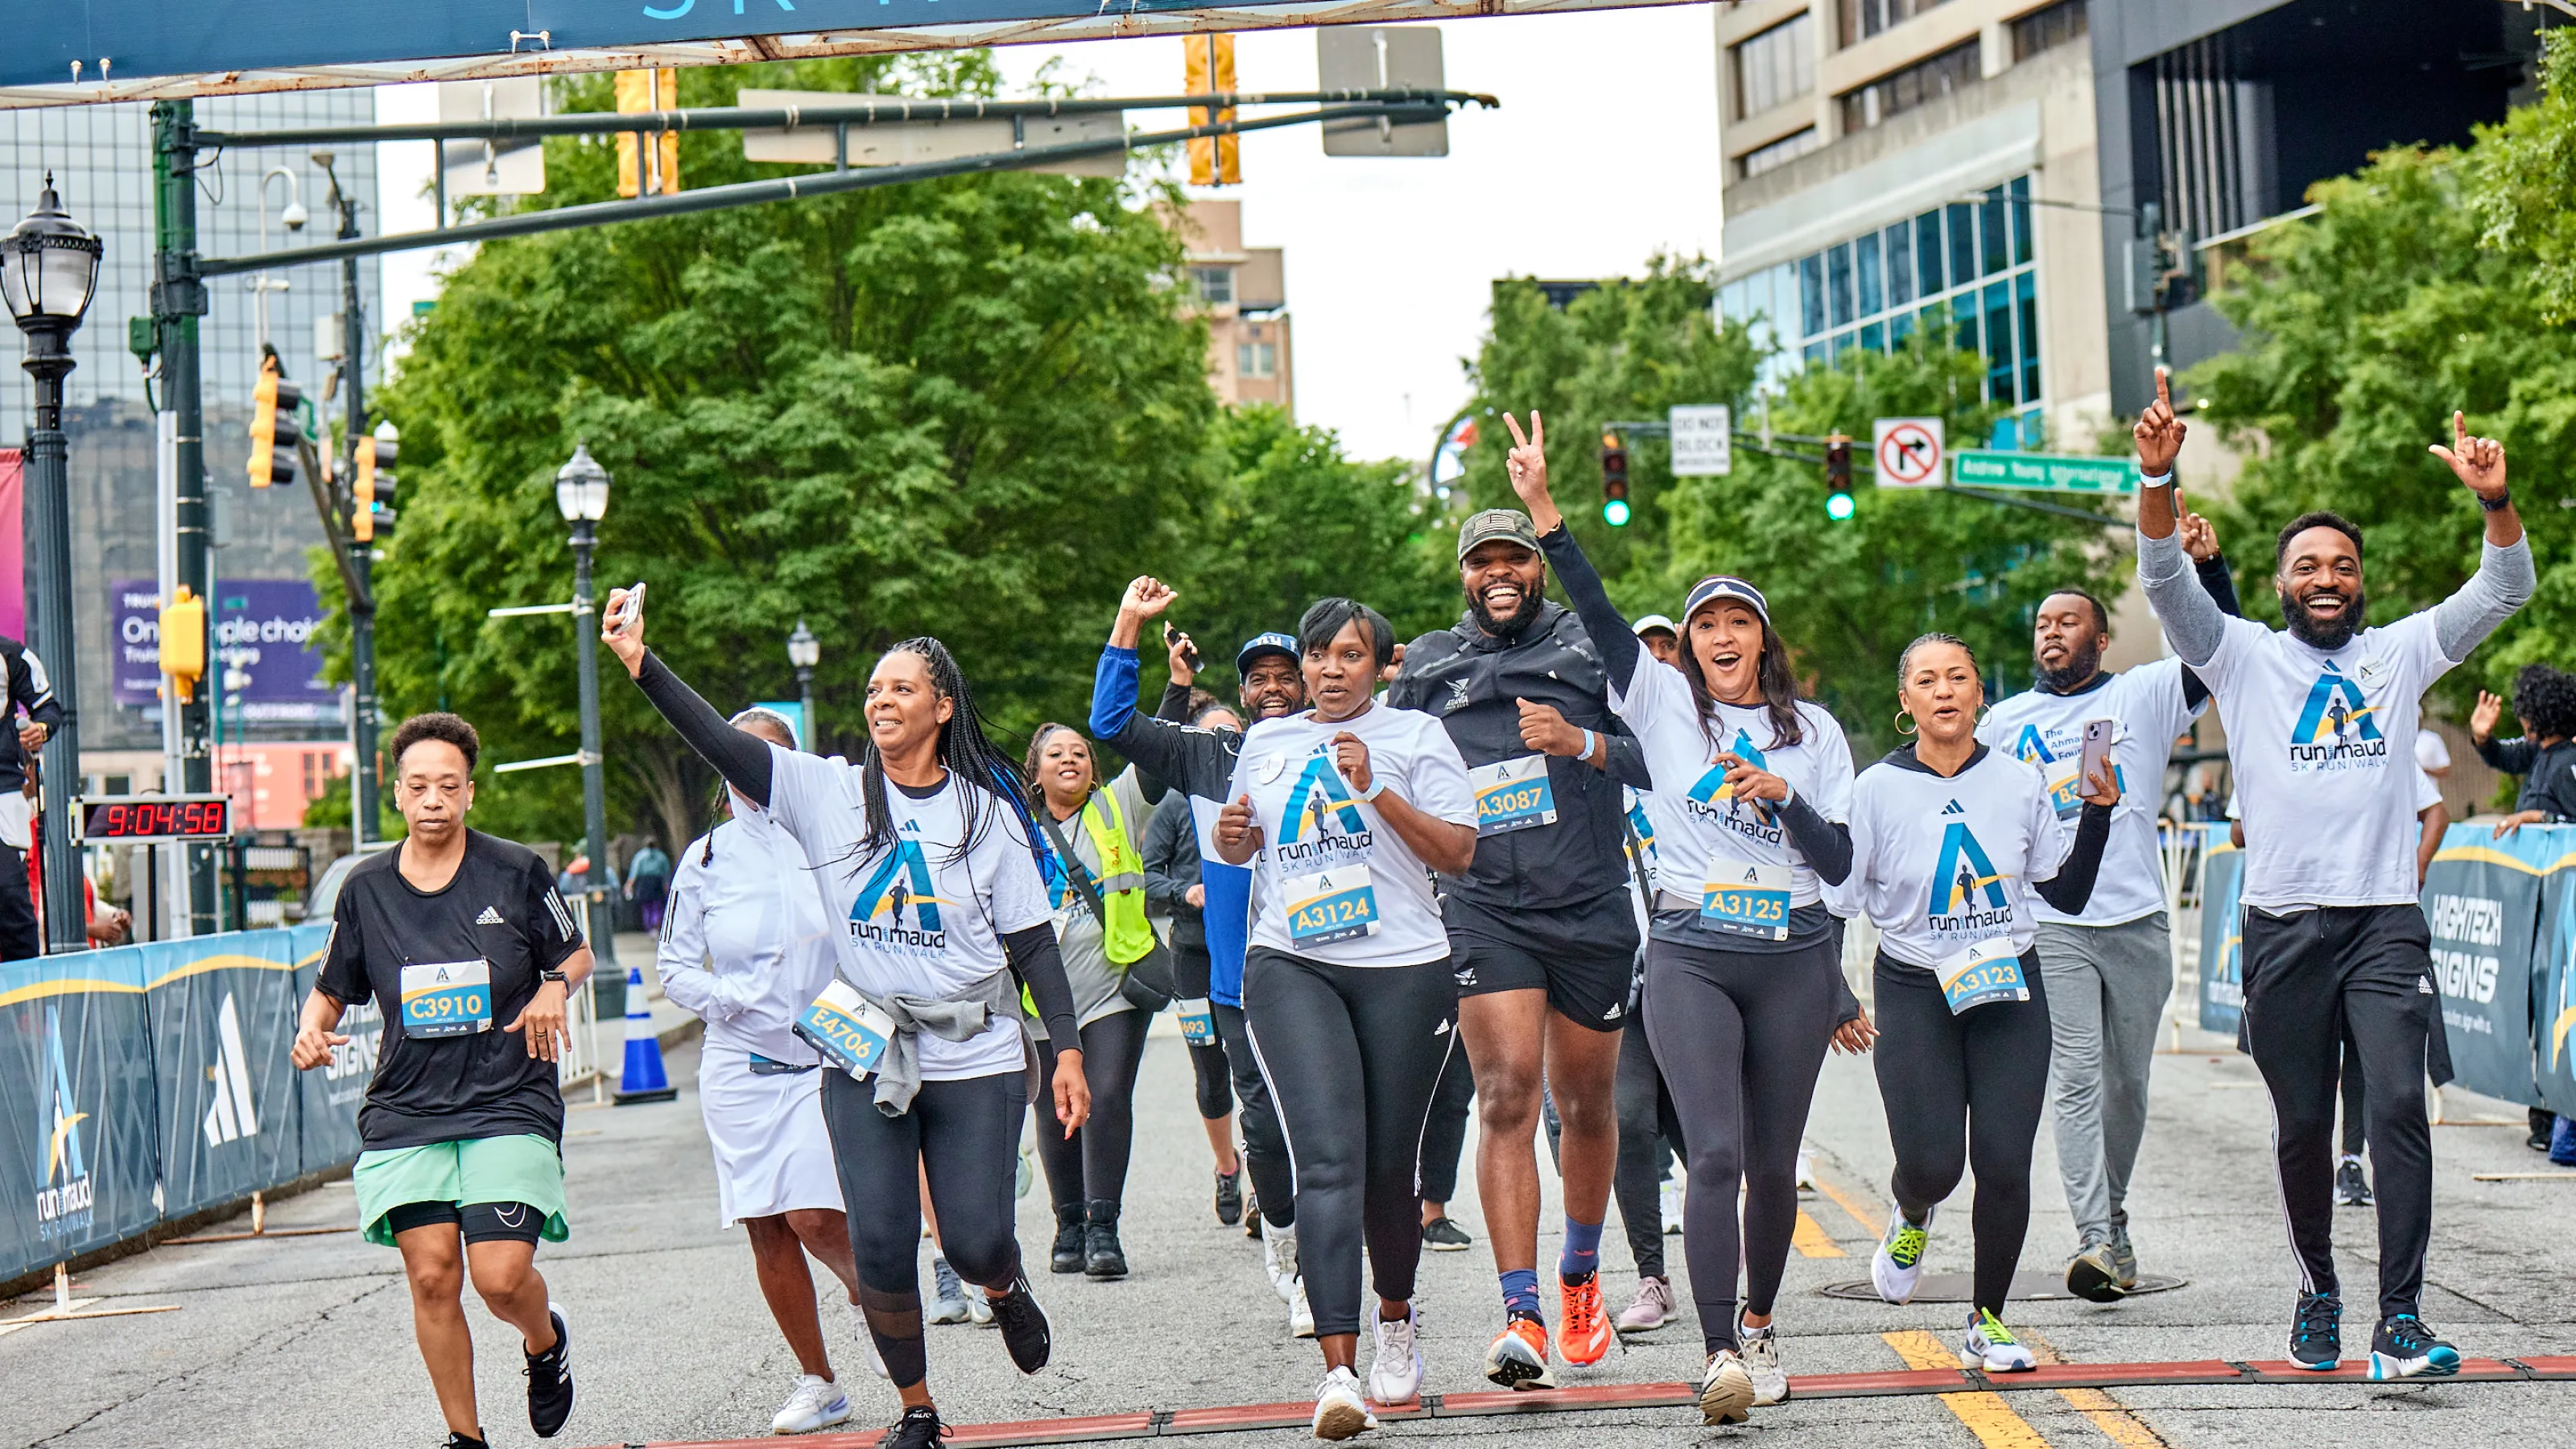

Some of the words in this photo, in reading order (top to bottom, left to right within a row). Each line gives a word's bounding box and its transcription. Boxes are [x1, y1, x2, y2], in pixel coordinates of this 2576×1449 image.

[2043, 728, 2063, 740] The
[2051, 737, 2083, 749] Ahma
[2289, 745, 2327, 762] run
[2334, 737, 2387, 759] maud
[2291, 762, 2310, 773] 5K
[2317, 757, 2389, 772] RUN/WALK
[1477, 787, 1543, 819] A3087
[107, 803, 223, 836] 9:04:58
[1686, 799, 1718, 819] run
[1724, 814, 1784, 845] maud
[1690, 814, 1707, 824] 5K
[1278, 842, 1312, 862] run
[1317, 830, 1373, 854] maud
[1282, 861, 1300, 873] 5K
[1305, 848, 1373, 869] RUN/WALK
[1296, 896, 1370, 931] A3124
[1707, 892, 1784, 921] A3125
[1929, 915, 1960, 931] run
[1965, 902, 2013, 929] maud
[2431, 893, 2503, 947] HIGHTECH
[849, 922, 882, 942] run
[890, 928, 947, 949] maud
[852, 937, 868, 950] 5K
[873, 941, 946, 959] RUN/WALK
[1930, 931, 1944, 941] 5K
[1953, 965, 2018, 999] A3123
[2431, 947, 2500, 1005] SIGNS
[410, 994, 482, 1019] C3910
[810, 1007, 873, 1059] E4706
[36, 1187, 61, 1222] run
[62, 1169, 93, 1214] maud
